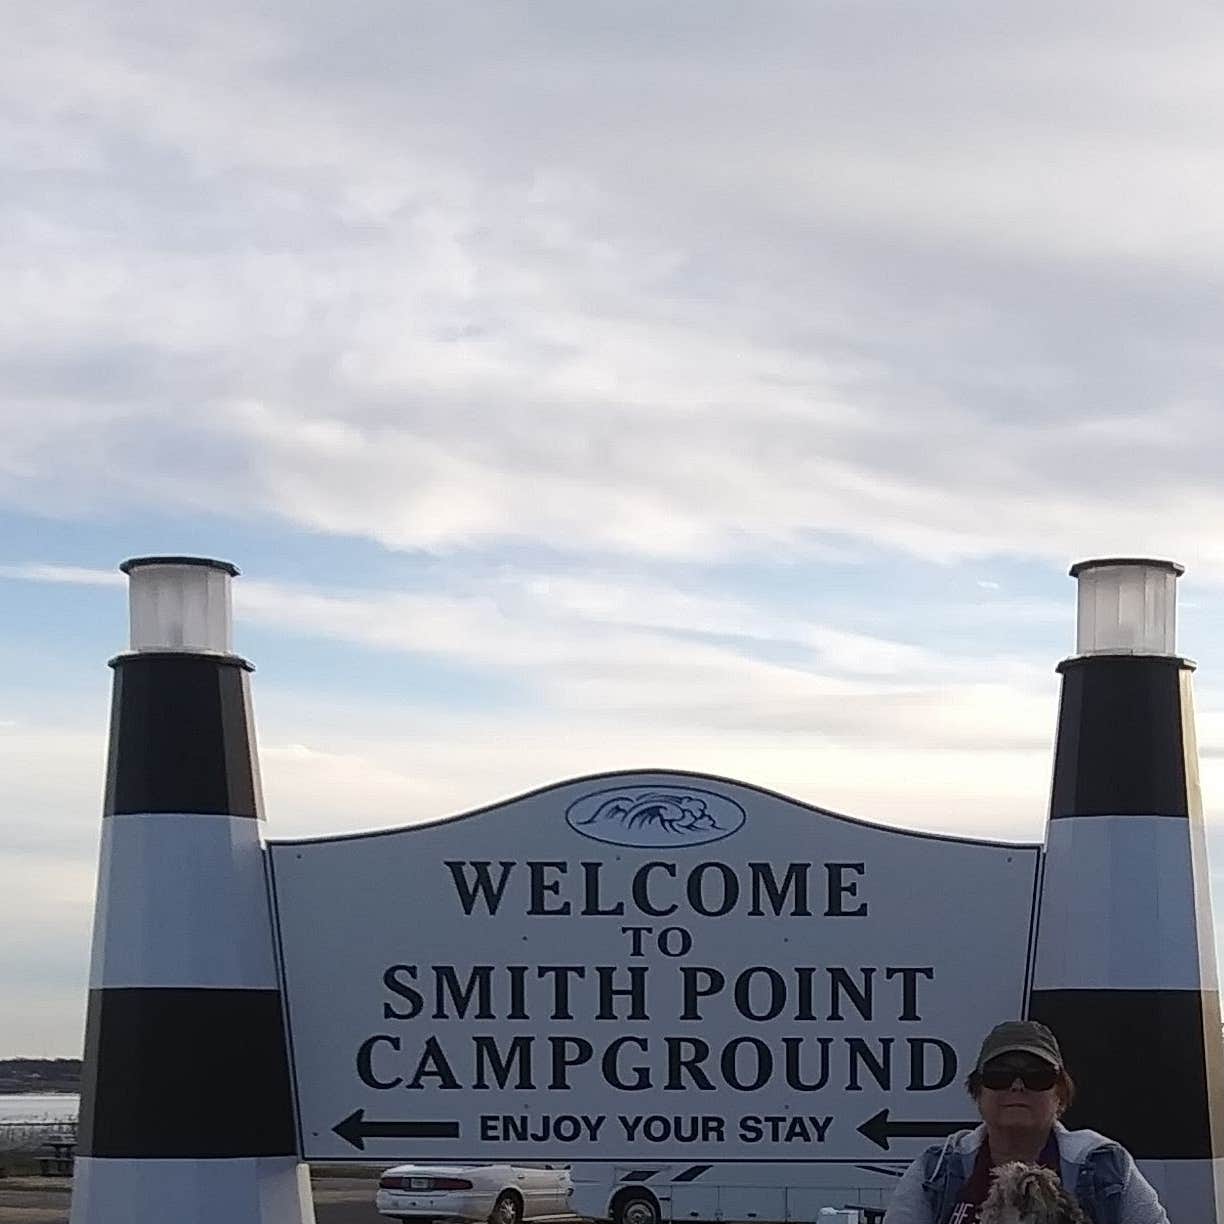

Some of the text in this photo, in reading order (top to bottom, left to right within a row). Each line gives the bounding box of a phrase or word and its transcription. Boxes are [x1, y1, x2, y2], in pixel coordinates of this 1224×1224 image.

[443, 860, 869, 918] WELCOME
[621, 926, 693, 958] TO
[382, 964, 935, 1022] SMITH POINT
[355, 1035, 959, 1092] CAMPGROUND
[480, 1115, 834, 1143] ENJOY YOUR STAY
